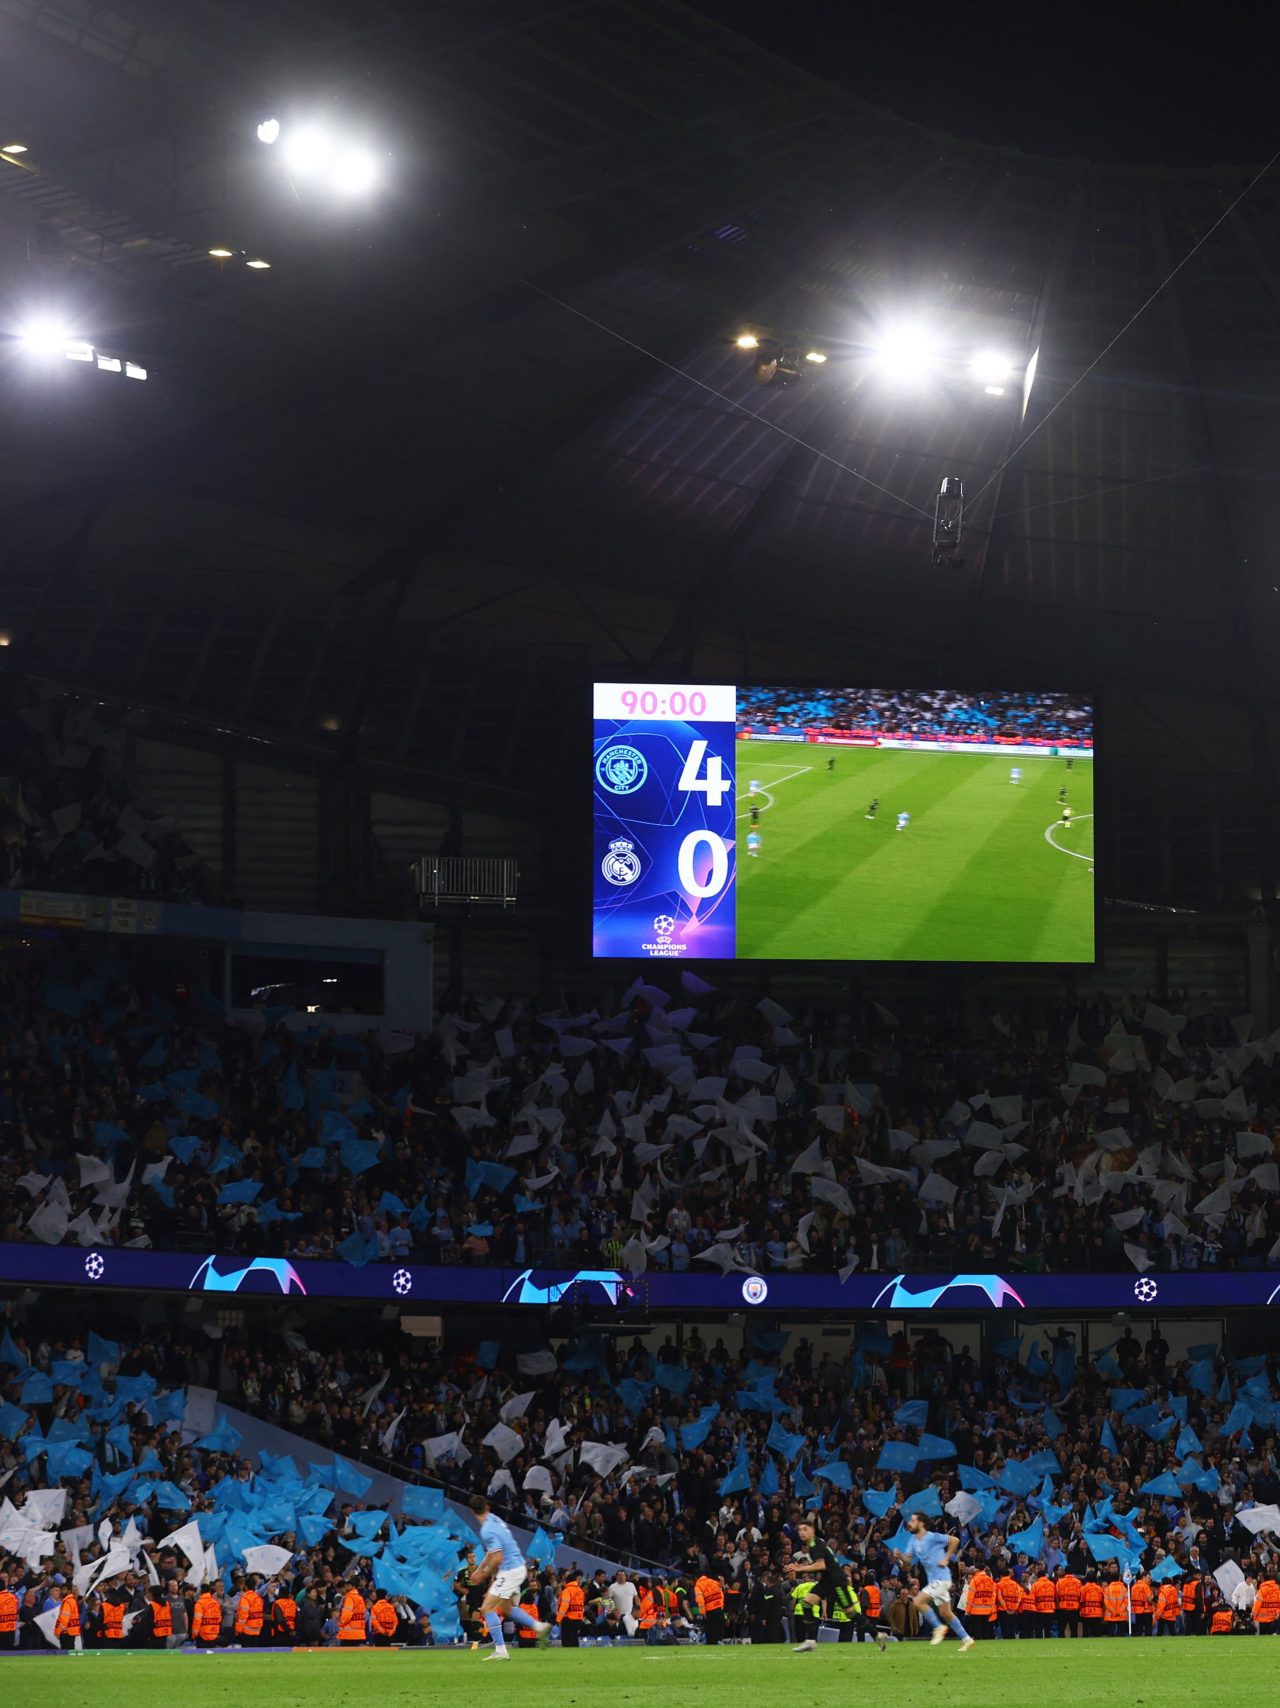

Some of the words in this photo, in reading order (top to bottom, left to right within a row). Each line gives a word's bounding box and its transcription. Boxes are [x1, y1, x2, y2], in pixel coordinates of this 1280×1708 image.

[620, 690, 707, 716] 90:00
[602, 749, 642, 764] MANCHESTER
[678, 739, 732, 806] 4
[677, 829, 729, 898] 0
[641, 943, 687, 951] CHAMPIONS
